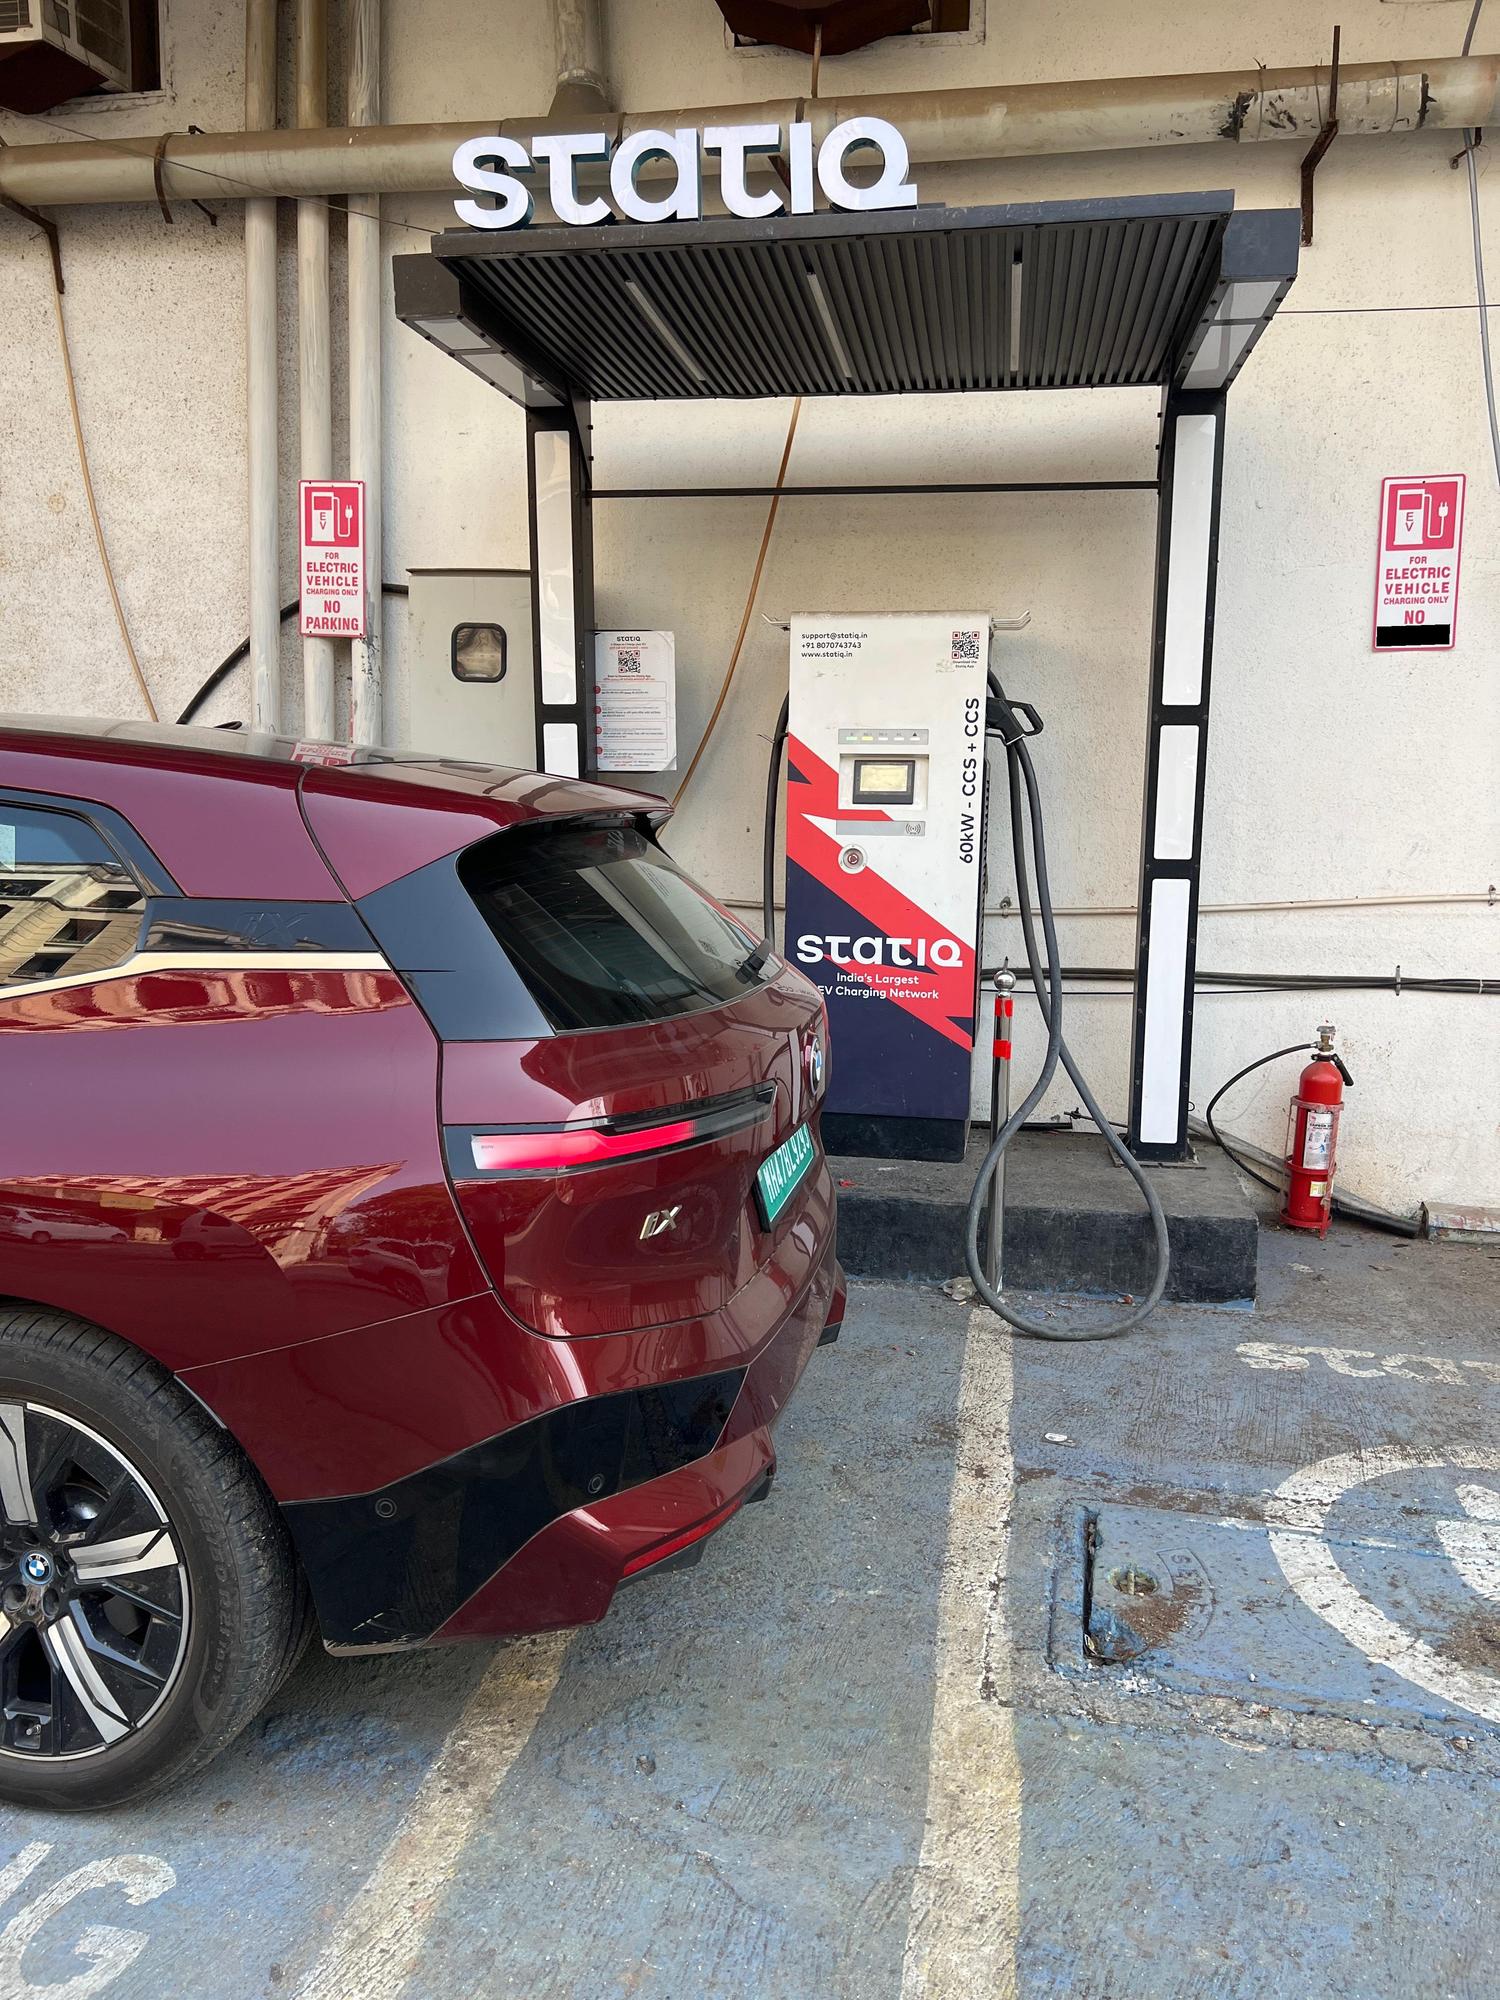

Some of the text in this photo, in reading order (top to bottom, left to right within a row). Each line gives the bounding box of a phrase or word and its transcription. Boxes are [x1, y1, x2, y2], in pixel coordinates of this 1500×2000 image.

[325, 552, 339, 560] FOR
[1409, 556, 1427, 565] FOR
[306, 562, 358, 573] ELECTRIC
[1386, 566, 1451, 580] ELECTRIC
[306, 575, 358, 587] VEHICLE
[306, 588, 340, 596] CHARGING
[1385, 582, 1450, 595] VEHICLE
[324, 600, 340, 614] NO
[1383, 596, 1449, 605] CHARGING ONLY
[306, 616, 359, 631] PARKING
[1404, 610, 1425, 624] NO
[801, 632, 868, 640] support@statiq.in
[965, 698, 980, 737] CCS
[962, 758, 977, 797] CCS
[959, 813, 975, 864] 60kW
[836, 972, 919, 985] India's Largest
[817, 985, 939, 999] EV Charging Network
